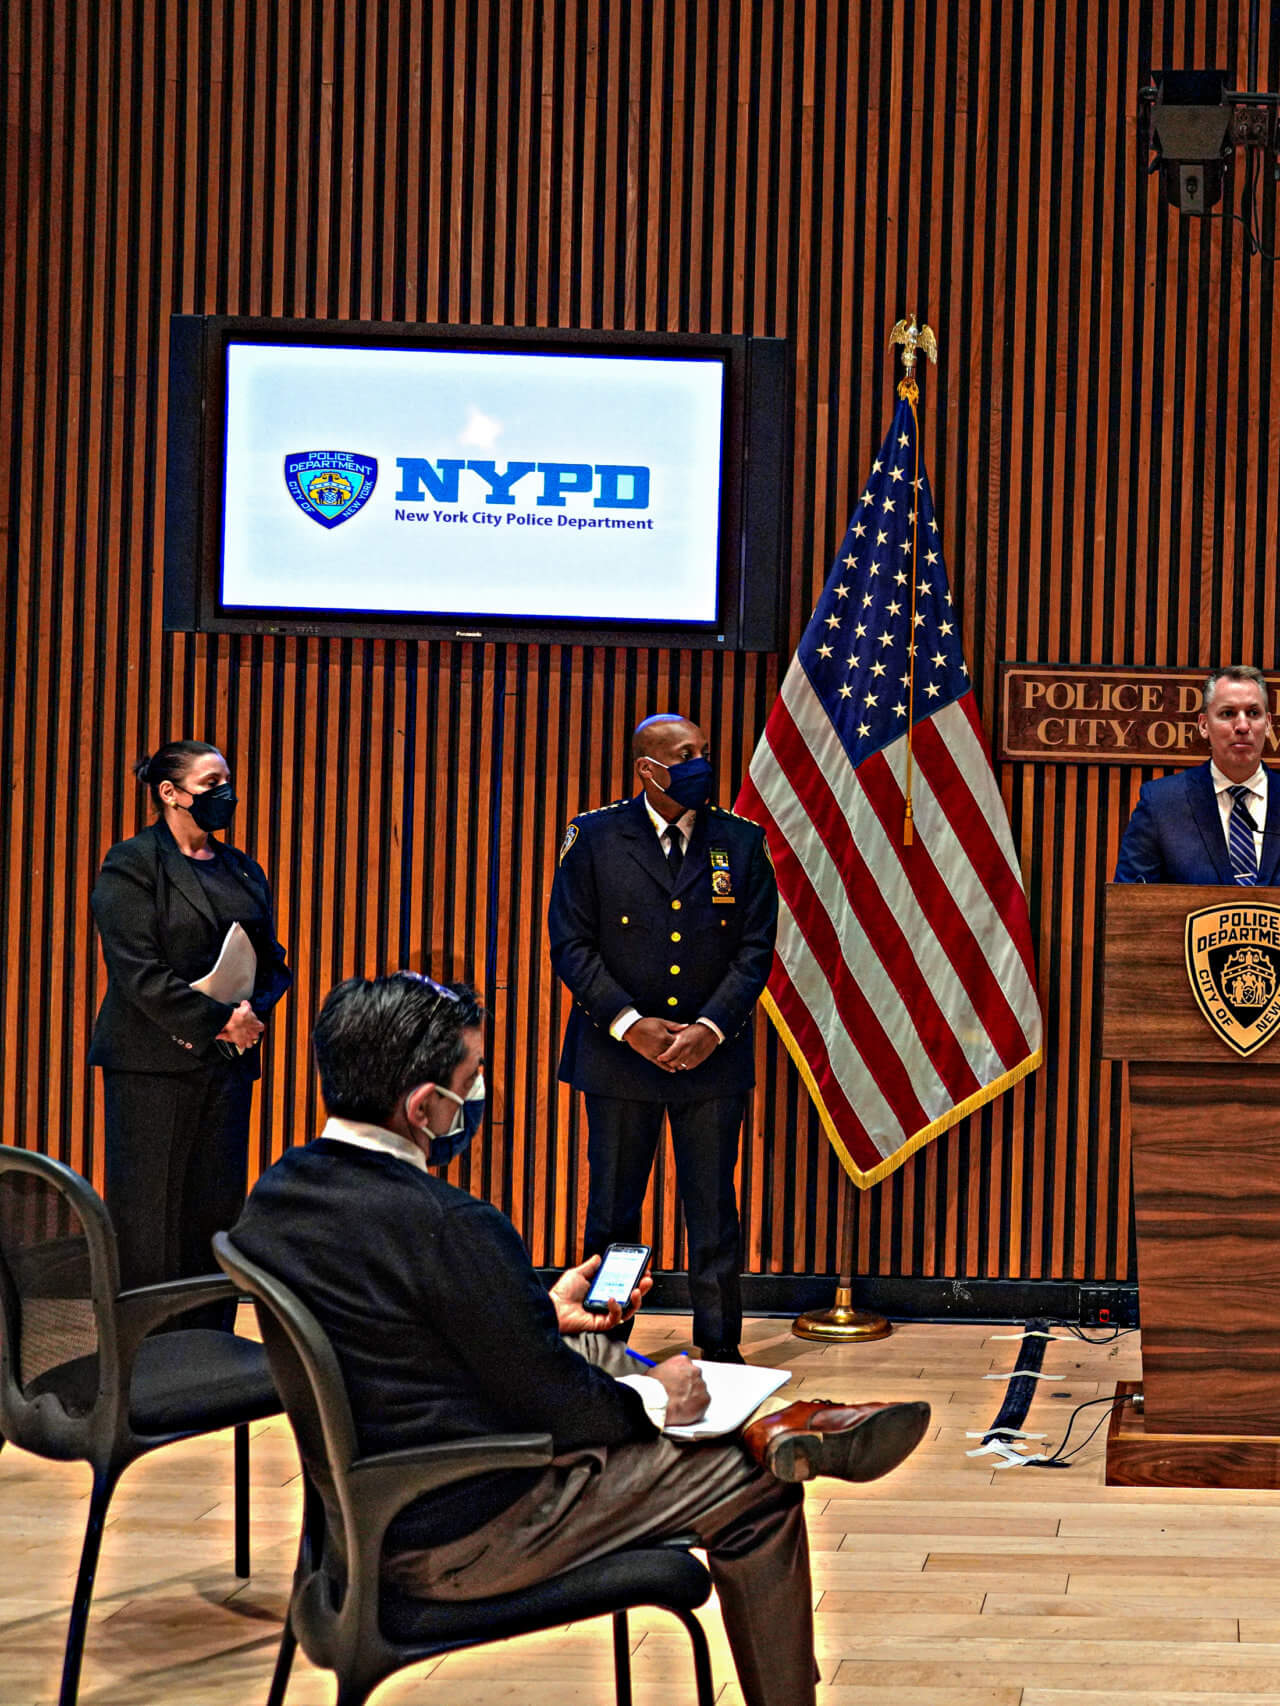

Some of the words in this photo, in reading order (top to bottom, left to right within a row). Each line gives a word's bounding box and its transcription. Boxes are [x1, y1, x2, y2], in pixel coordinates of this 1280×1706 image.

[289, 460, 373, 475] DEPARTMENT
[309, 452, 354, 462] POLICE
[289, 481, 304, 500] CITY
[301, 502, 315, 513] OF
[342, 500, 361, 517] NEW
[358, 481, 373, 500] YORK
[395, 457, 650, 510] NYPD
[394, 509, 429, 522] New
[433, 510, 468, 524] York
[472, 512, 502, 527] City
[506, 513, 553, 526] Police
[558, 515, 654, 530] Department
[1022, 681, 1165, 712] POLICE
[1037, 717, 1135, 747] CITY
[1147, 721, 1199, 749] OF
[1219, 912, 1279, 931] POLICE
[1199, 968, 1219, 1003] CITY
[1216, 1008, 1234, 1027] OF
